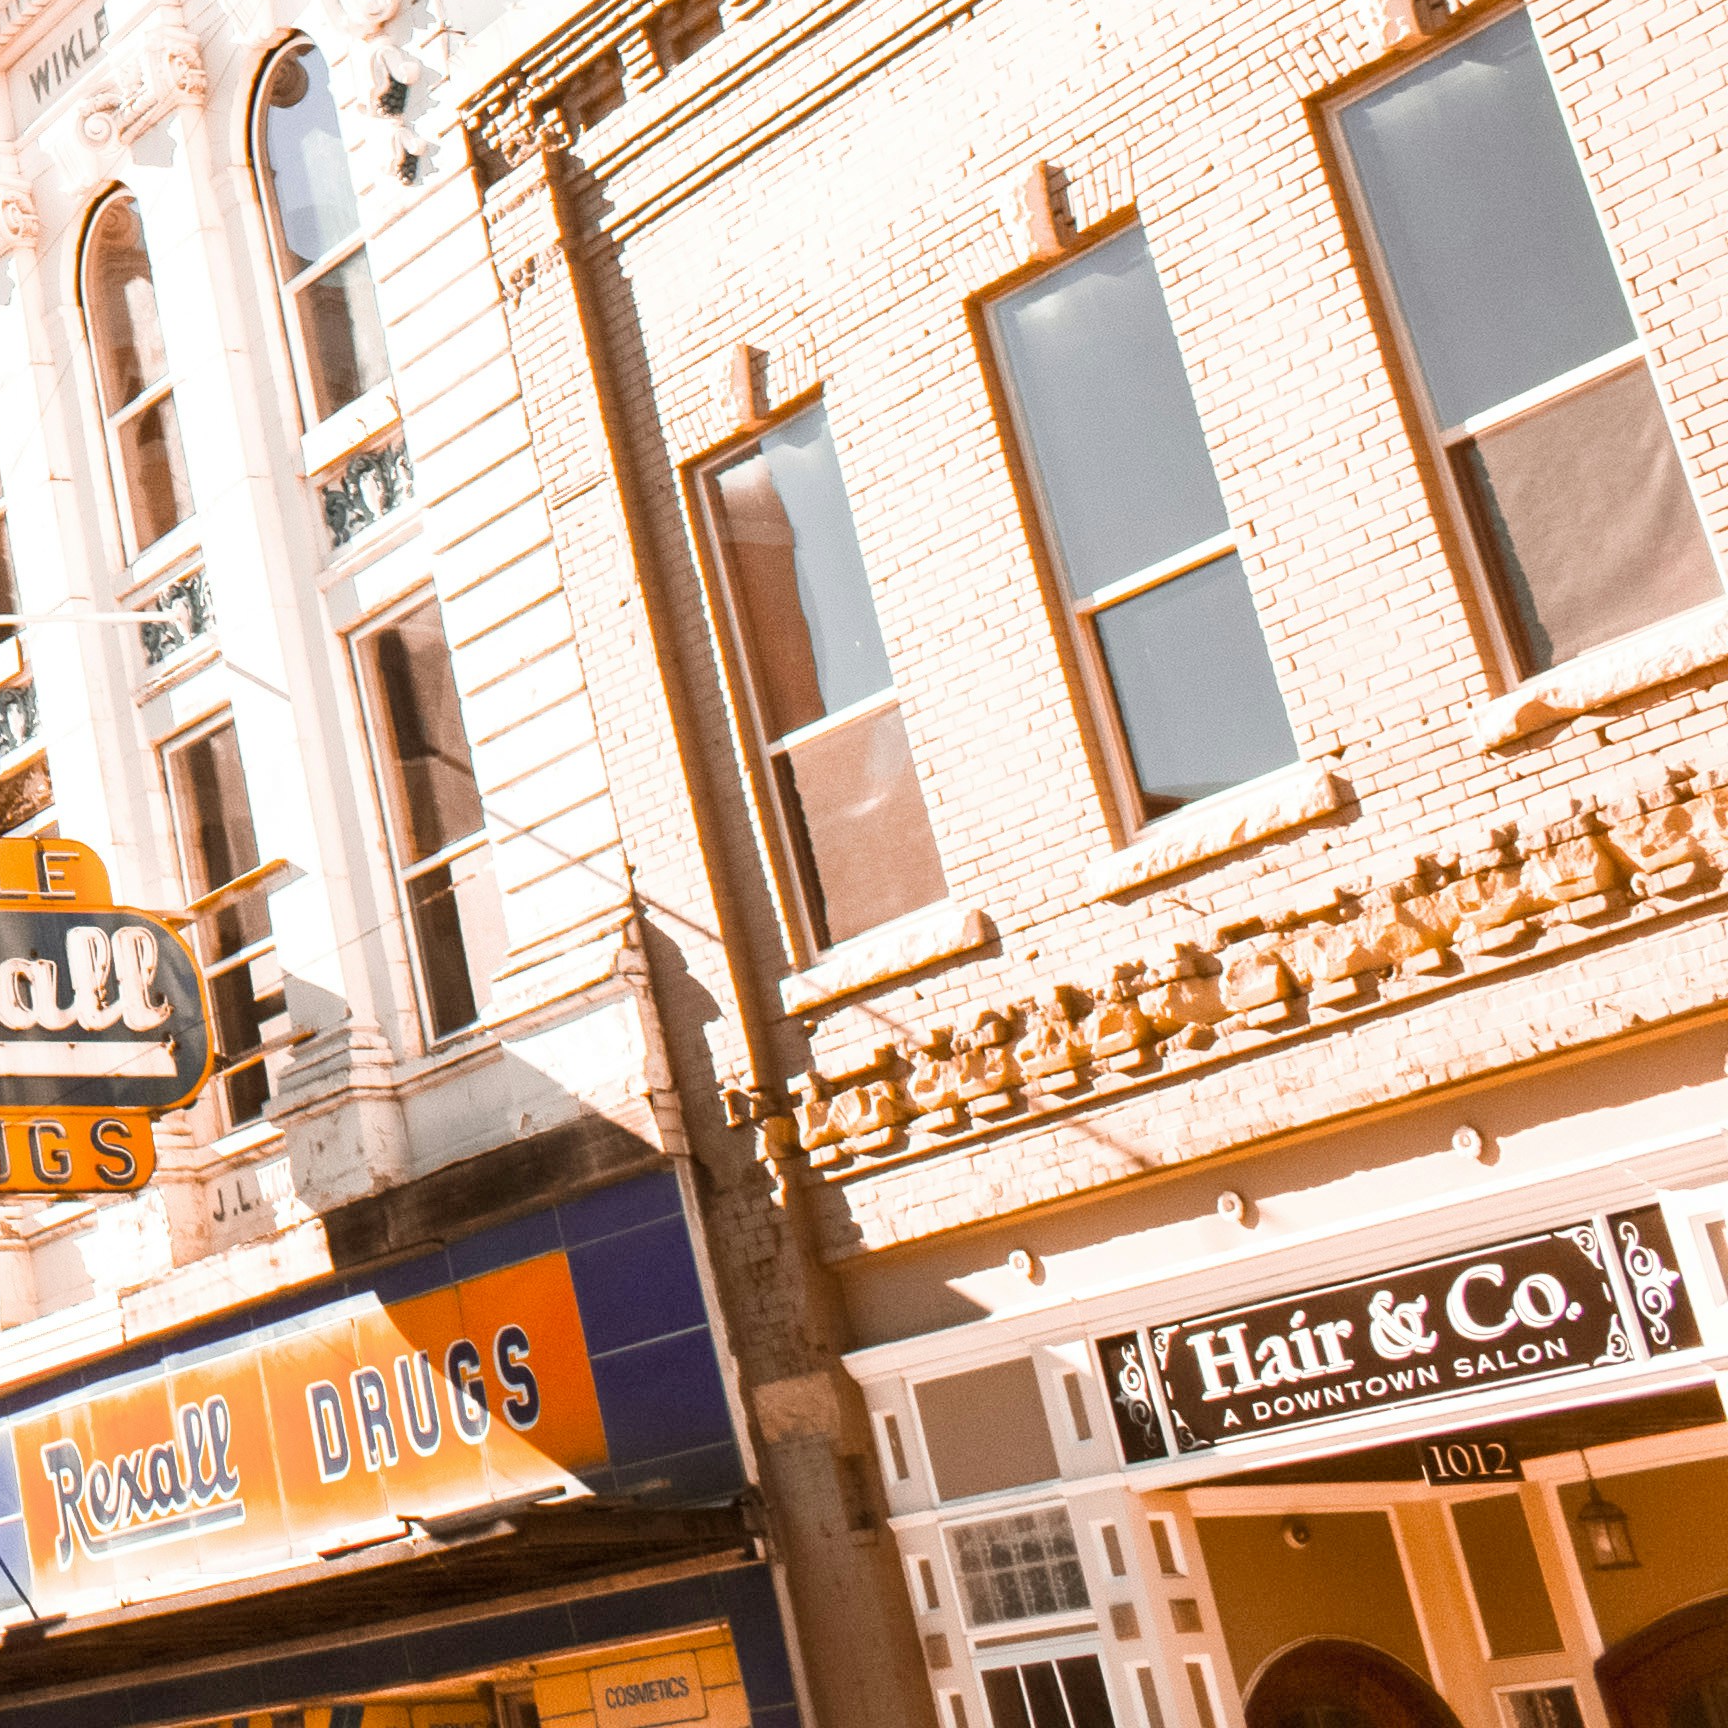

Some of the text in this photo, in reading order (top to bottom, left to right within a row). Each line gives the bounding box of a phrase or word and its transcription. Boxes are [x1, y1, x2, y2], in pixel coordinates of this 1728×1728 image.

[29, 3, 110, 104] WIKLE
[1186, 1263, 1584, 1401] Hair & Co.
[1223, 1337, 1569, 1428] A DOWNTOWN SALON
[41, 1324, 541, 1571] Rexall DRUGS
[1428, 1443, 1513, 1478] 1012
[605, 1676, 689, 1709] COSMETICS
